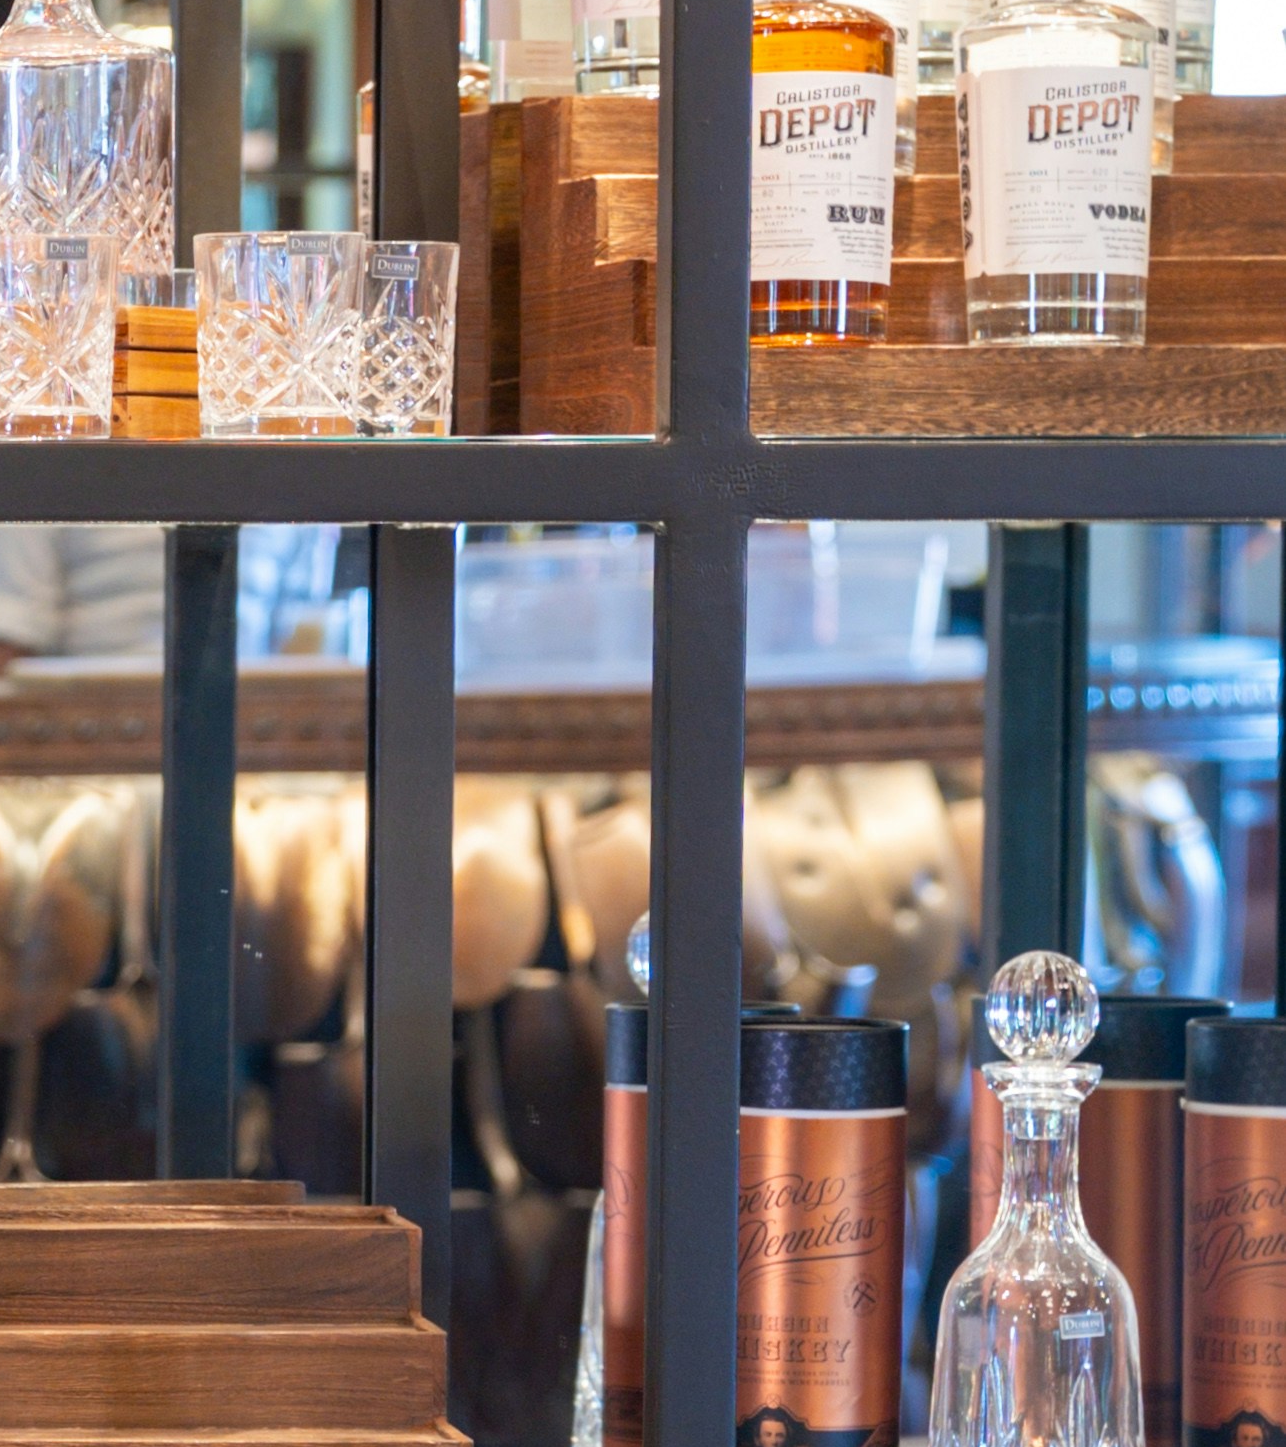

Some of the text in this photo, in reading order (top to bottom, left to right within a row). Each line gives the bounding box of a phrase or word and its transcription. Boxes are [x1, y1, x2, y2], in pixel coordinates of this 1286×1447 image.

[777, 84, 861, 105] CALISTOGA
[1045, 80, 1127, 101] CALISTOGA
[759, 98, 876, 147] DEPOT
[1028, 94, 1140, 143] DEPOT
[786, 136, 858, 154] DISTILLERY
[1054, 132, 1125, 150] DISTILLERY
[1096, 148, 1118, 156] 1868
[827, 204, 885, 226] RUM
[1089, 204, 1146, 223] VODKA
[49, 240, 87, 254] DUBLIN
[290, 237, 328, 251] DUBLIN
[377, 257, 416, 274] DUBLIN
